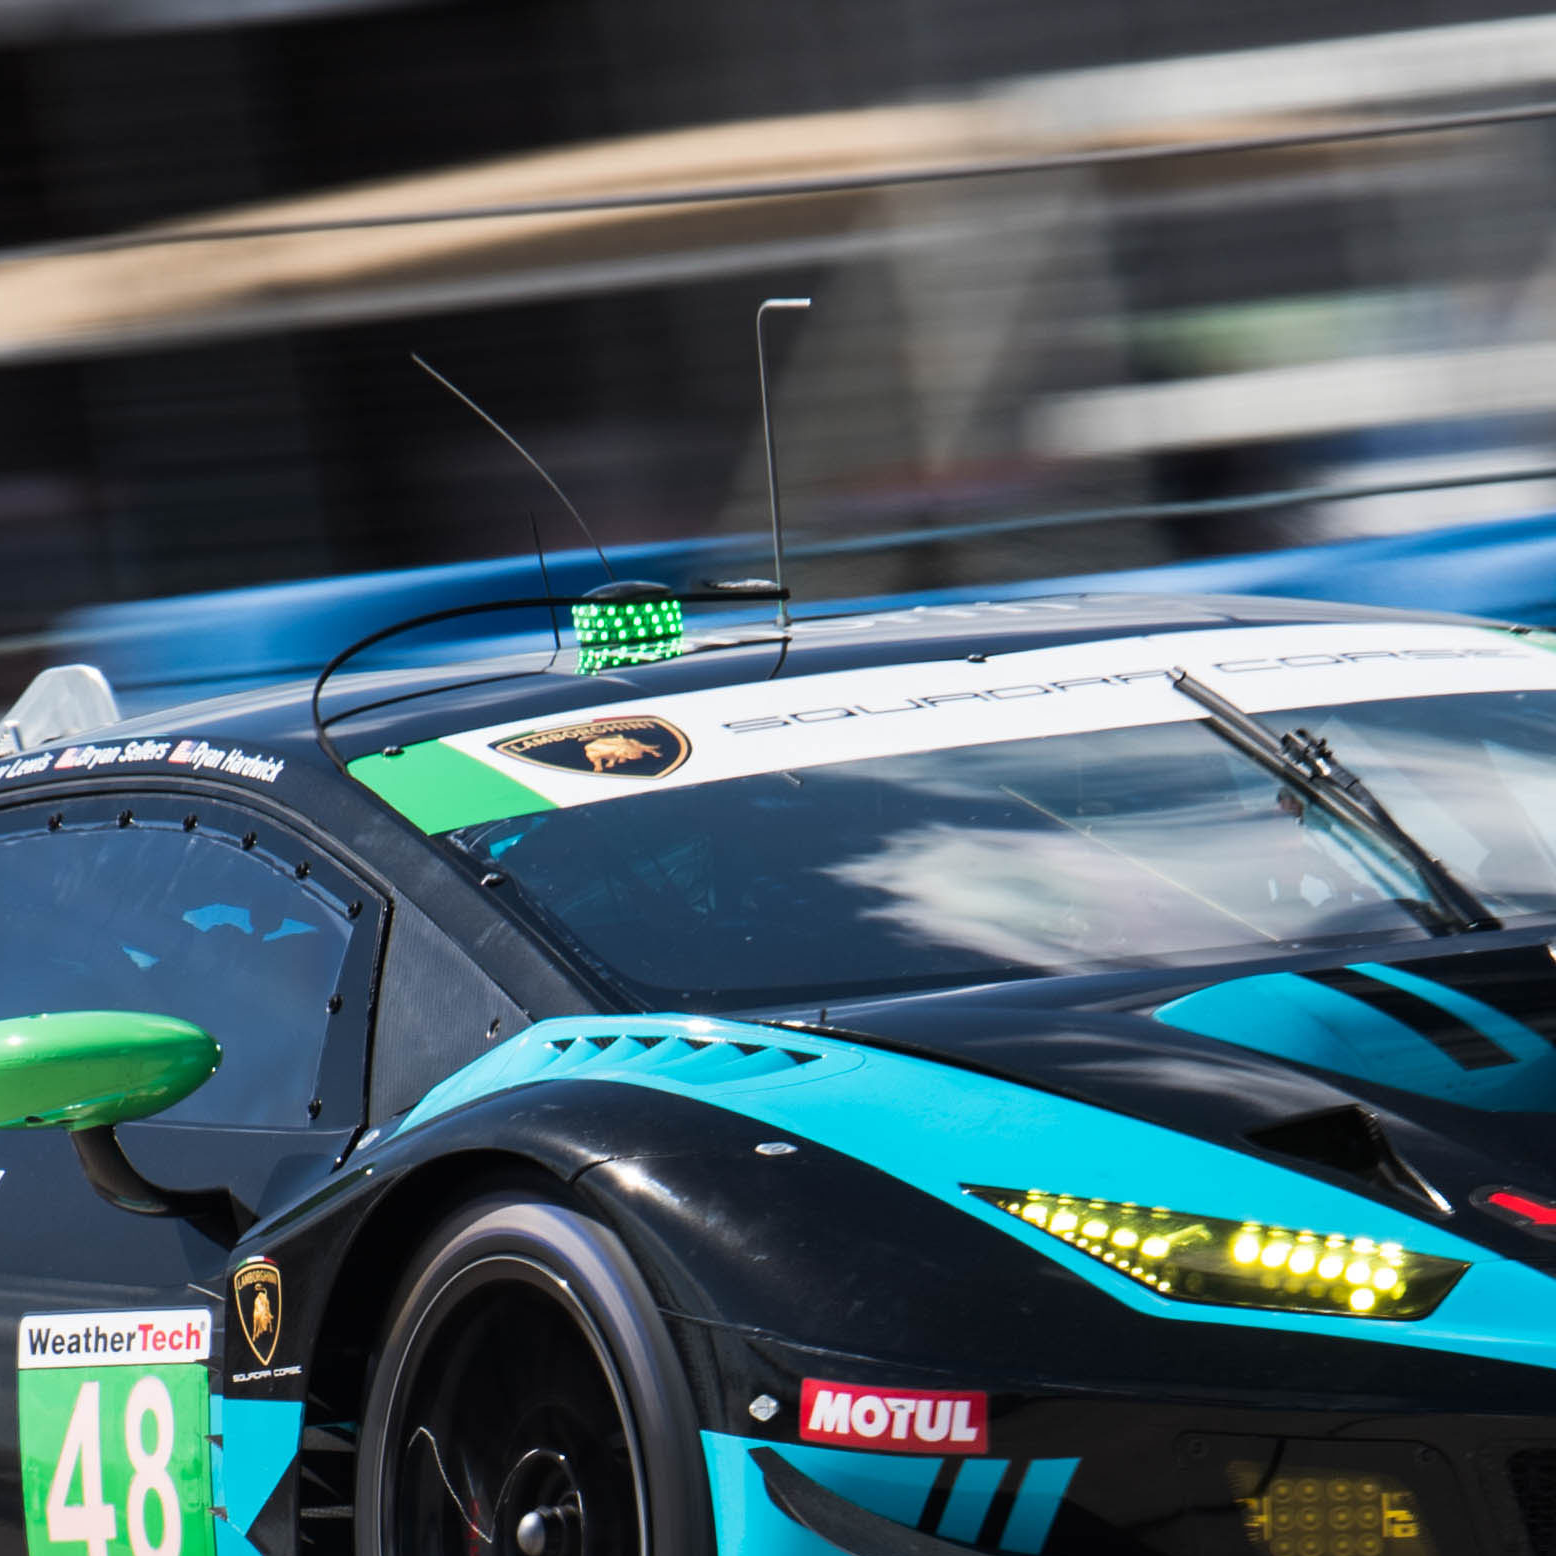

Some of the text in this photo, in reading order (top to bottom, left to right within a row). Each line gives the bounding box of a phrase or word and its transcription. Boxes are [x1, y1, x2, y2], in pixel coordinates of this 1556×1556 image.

[720, 647, 1532, 734] SQUADRA CORSE
[118, 739, 172, 763] Sellers
[509, 719, 656, 753] LAMBORGHINI
[4, 752, 55, 778] Lewis
[188, 740, 285, 784] Ryan Hardwick
[807, 1389, 980, 1443] MOTUL
